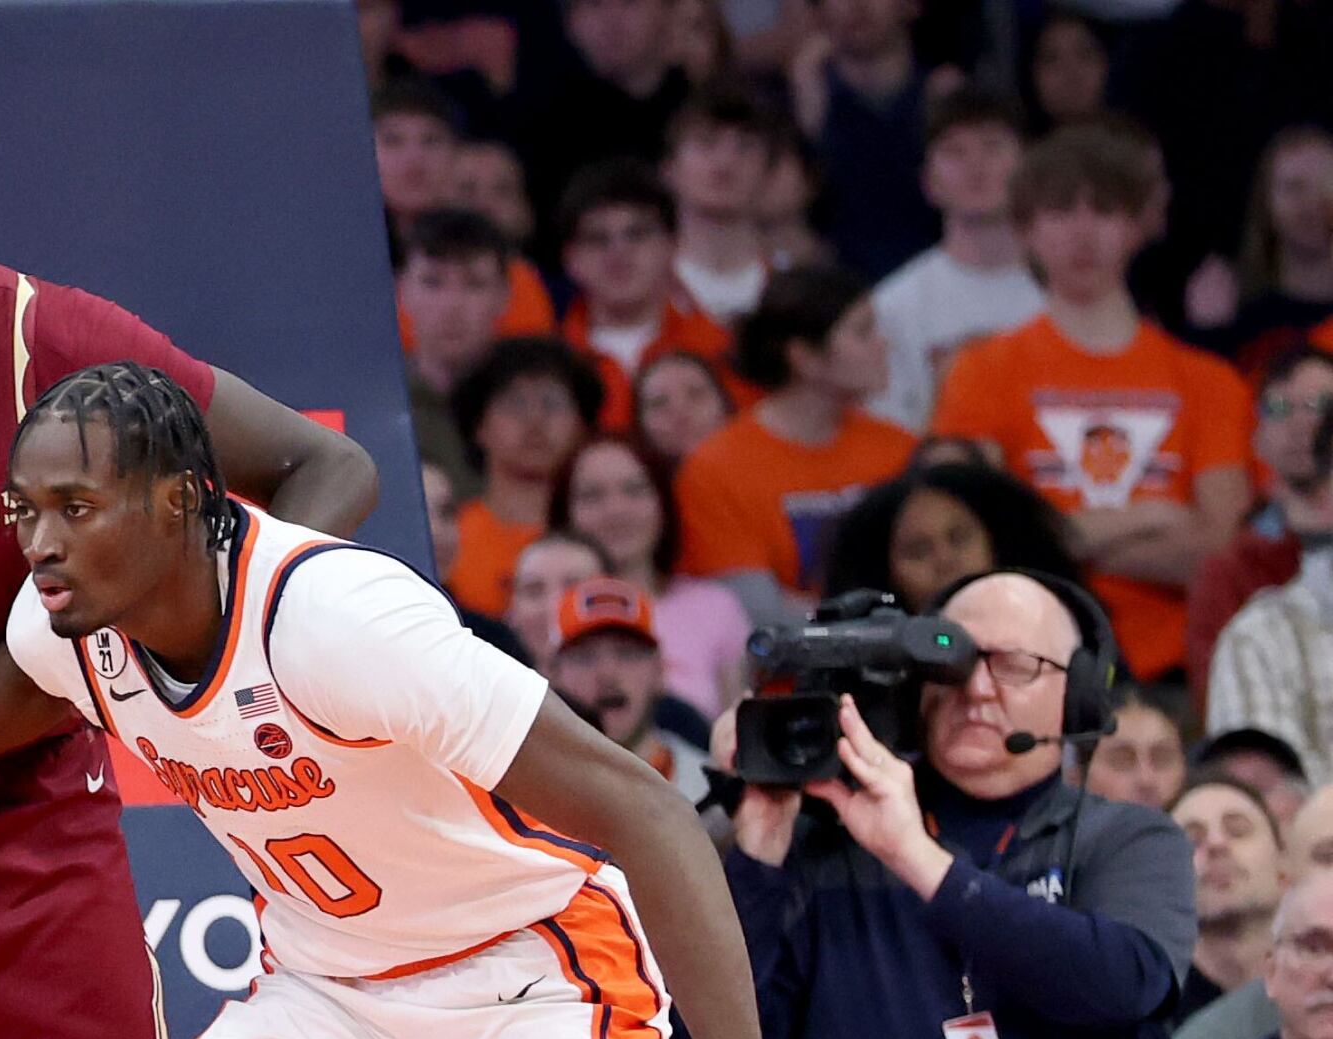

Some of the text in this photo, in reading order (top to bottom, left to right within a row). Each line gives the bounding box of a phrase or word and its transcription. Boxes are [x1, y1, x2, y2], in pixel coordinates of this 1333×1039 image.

[99, 650, 114, 672] 21
[136, 736, 336, 819] Syracuse
[226, 832, 382, 919] 10
